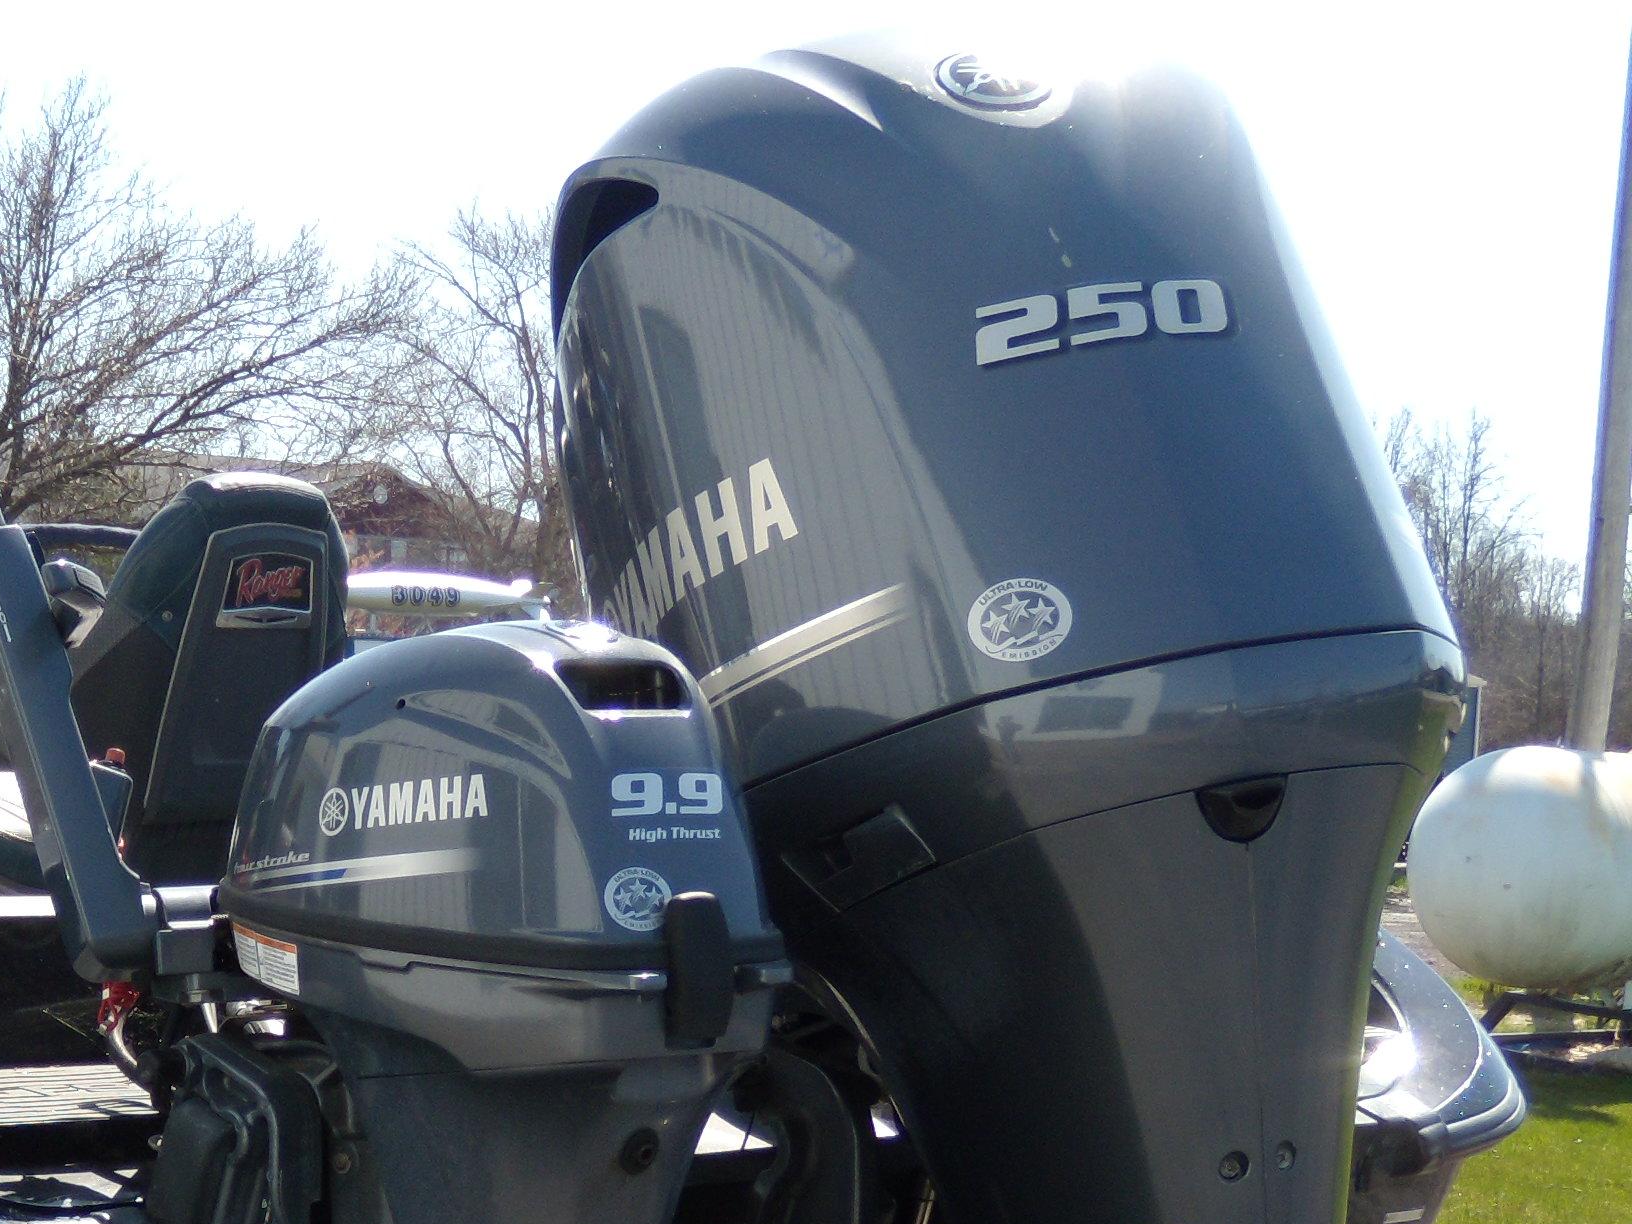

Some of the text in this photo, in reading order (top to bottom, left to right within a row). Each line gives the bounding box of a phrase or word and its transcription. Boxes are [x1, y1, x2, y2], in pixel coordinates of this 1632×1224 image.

[975, 279, 1229, 366] 250
[613, 457, 799, 642] YAMAHA
[235, 557, 307, 608] Ranger
[391, 584, 461, 607] 3049
[978, 580, 1048, 607] ULTRA LOW
[350, 772, 489, 831] YAMAHA
[611, 772, 723, 818] 9.9
[628, 826, 721, 843] High Thrust
